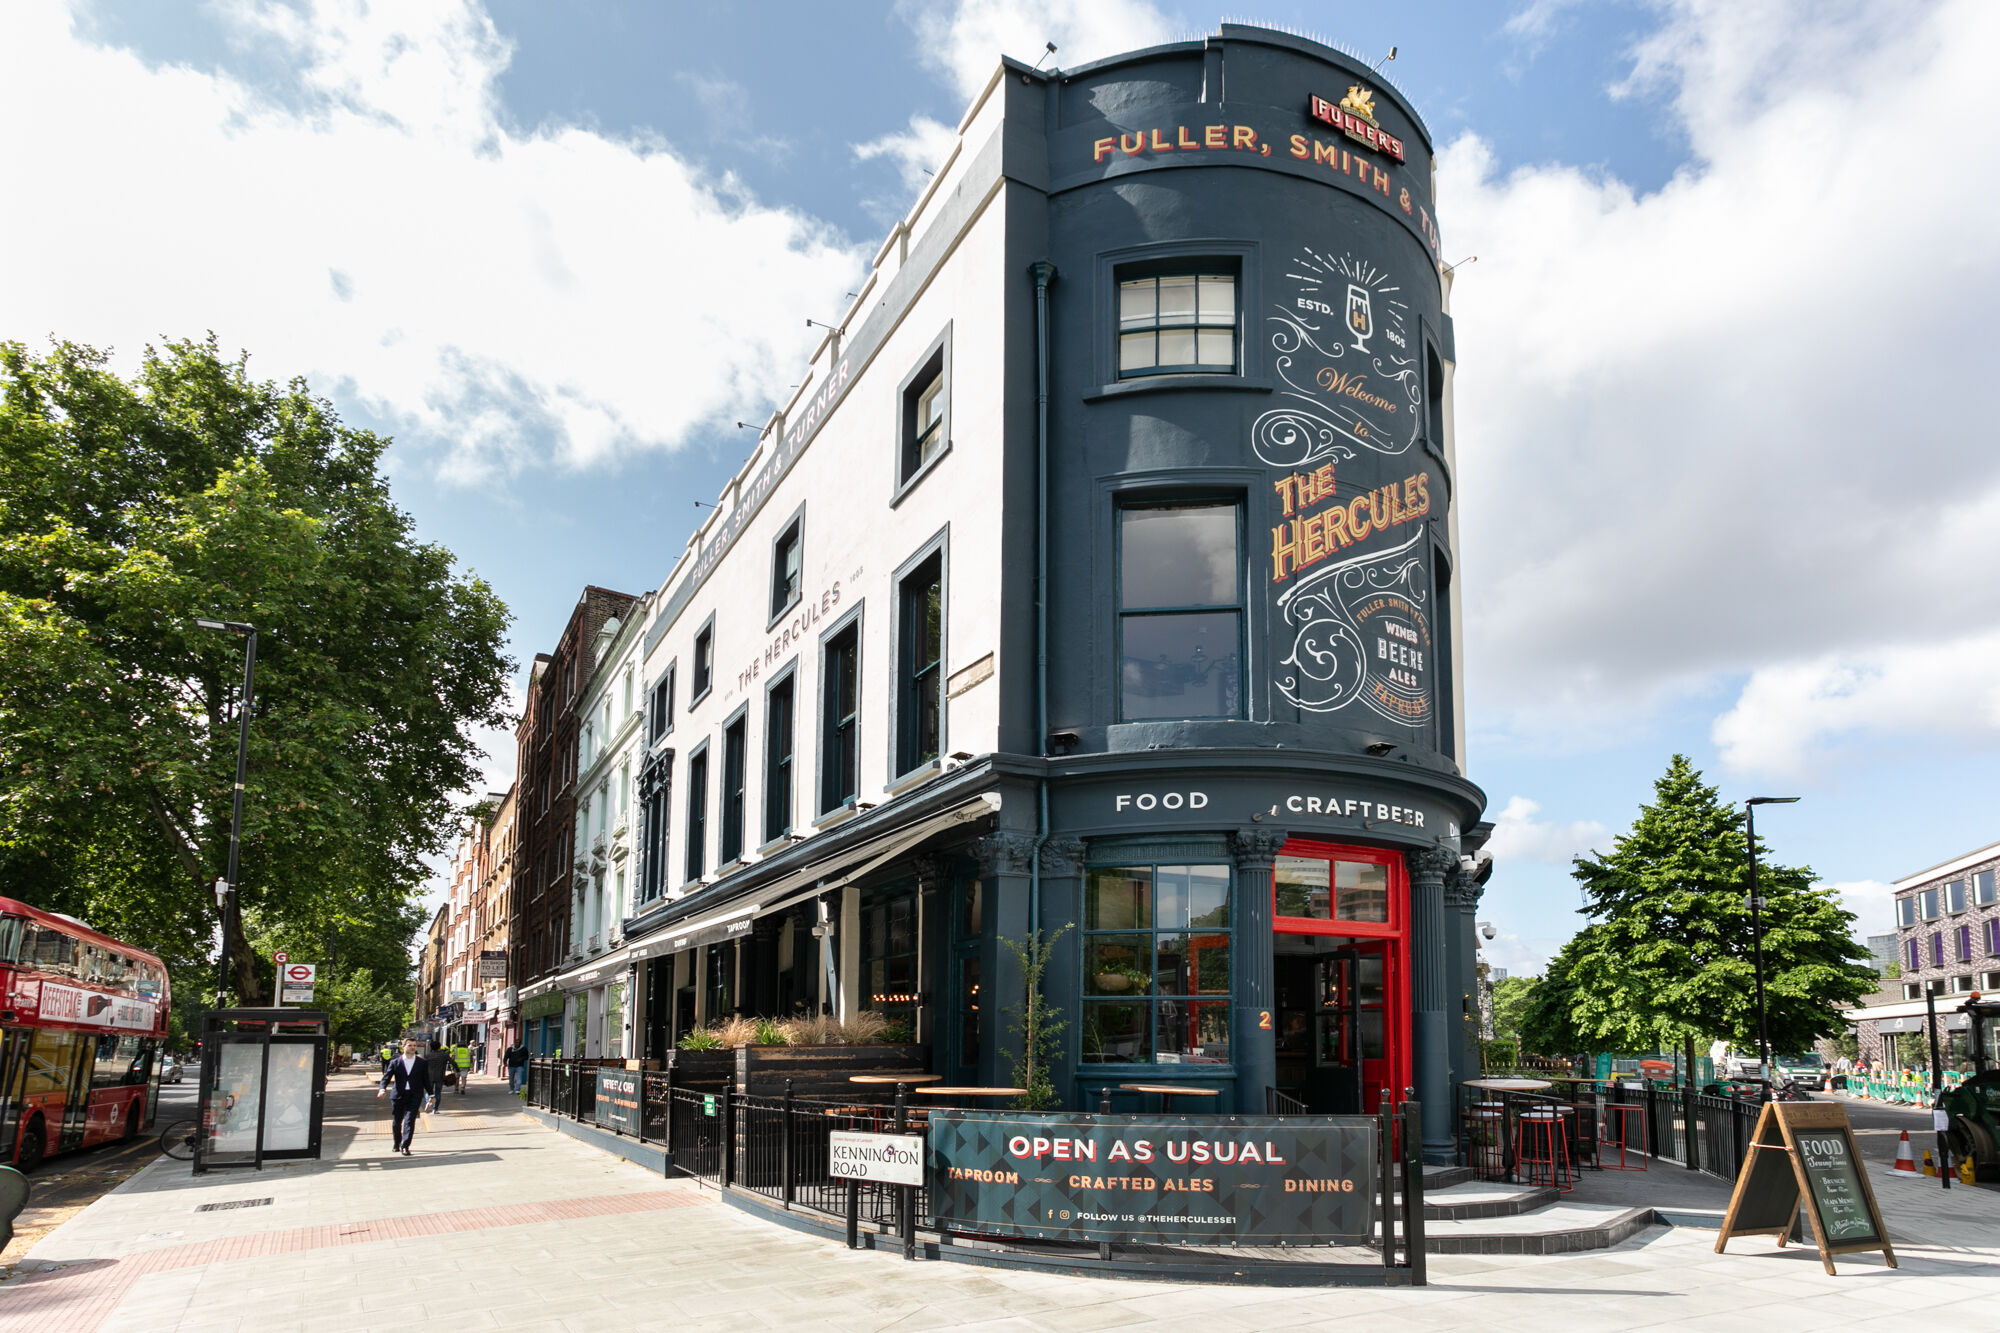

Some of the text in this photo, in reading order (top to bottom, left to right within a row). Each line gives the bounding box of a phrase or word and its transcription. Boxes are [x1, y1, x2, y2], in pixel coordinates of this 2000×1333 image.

[1318, 98, 1400, 154] FULLER'S
[1094, 124, 1271, 162] FULLER,
[1289, 134, 1390, 197] SMITH
[1399, 187, 1412, 215] &
[1297, 298, 1334, 315] ESTD.
[1385, 329, 1405, 348] 1805
[1316, 367, 1397, 413] Welcome
[1353, 420, 1370, 438] to
[735, 468, 771, 530] SMITH
[787, 357, 850, 456] TURNER
[1275, 461, 1336, 518] THE
[1271, 471, 1430, 583] HERCULES
[738, 580, 841, 693] THE HERCULES
[1385, 621, 1418, 645] WINES
[1389, 667, 1417, 688] ALES
[1115, 791, 1209, 812] FOOD
[1286, 795, 1372, 818] CRAFT
[275, 952, 286, 963] G
[41, 986, 79, 1018] BEEFSTEAK
[1258, 1010, 1272, 1030] 2
[833, 1145, 919, 1165] KENNINGTON
[1008, 1135, 1287, 1165] OPEN AS USUAL
[1800, 1138, 1844, 1156] FOOD
[833, 1161, 867, 1176] ROAD
[947, 1166, 1354, 1194] TAPROOM CRAFTED ALES DINING
[1076, 1211, 1237, 1226] FOLLOW US @THEHERCULESSE1
